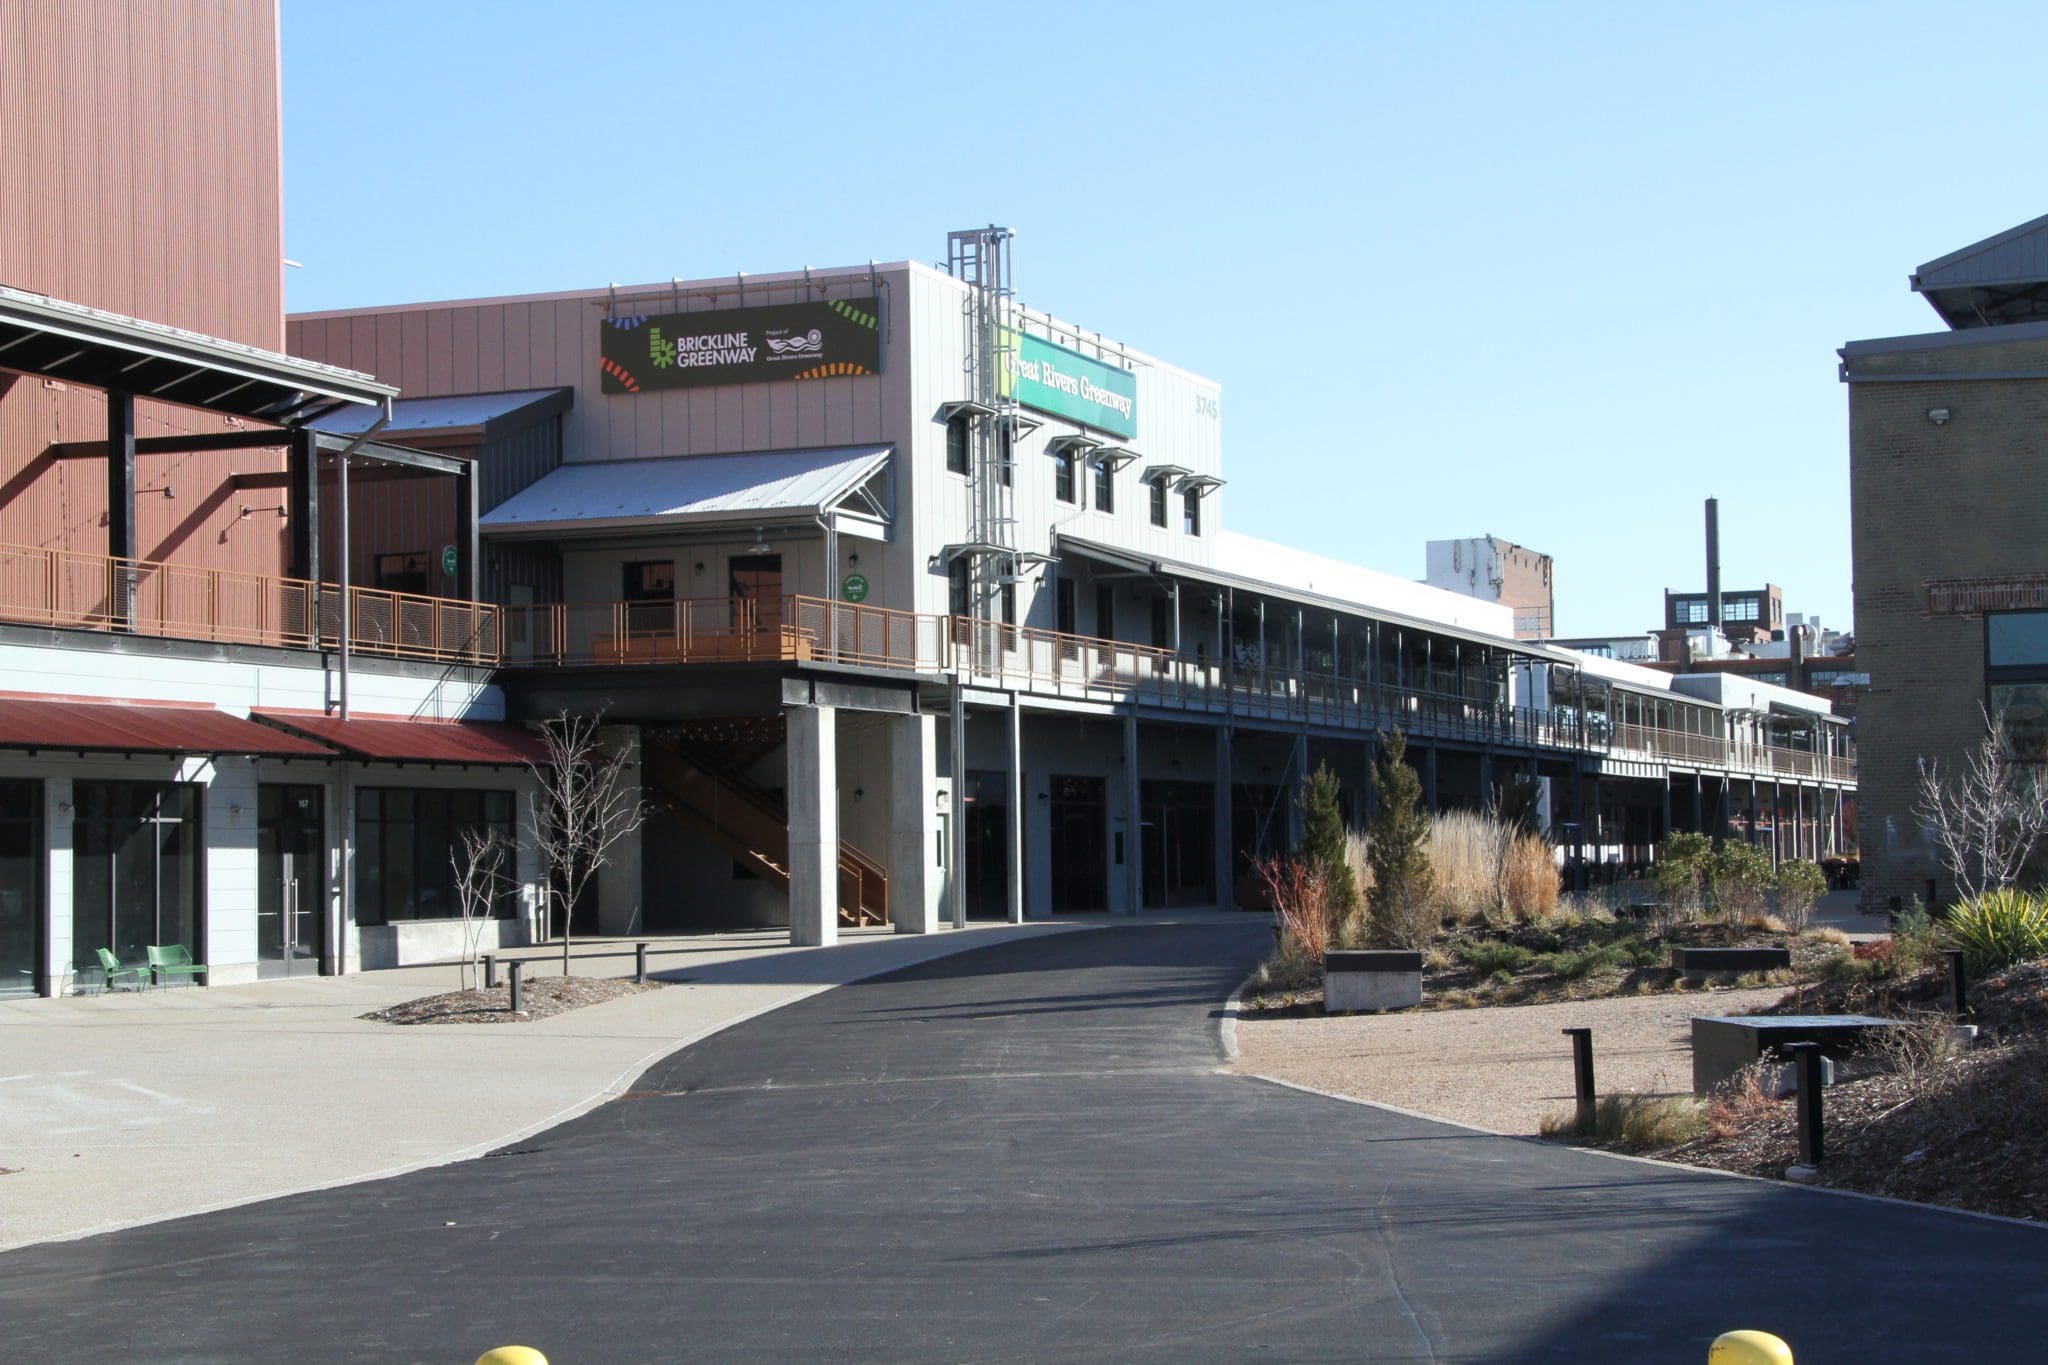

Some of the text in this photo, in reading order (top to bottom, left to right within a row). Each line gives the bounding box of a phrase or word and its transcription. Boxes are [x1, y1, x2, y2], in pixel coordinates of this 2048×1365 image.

[677, 332, 748, 352] BRICKLINE
[677, 347, 757, 368] GREENWAY
[1004, 350, 1132, 420] Great Rivers Greenway
[1195, 393, 1218, 420] 3745
